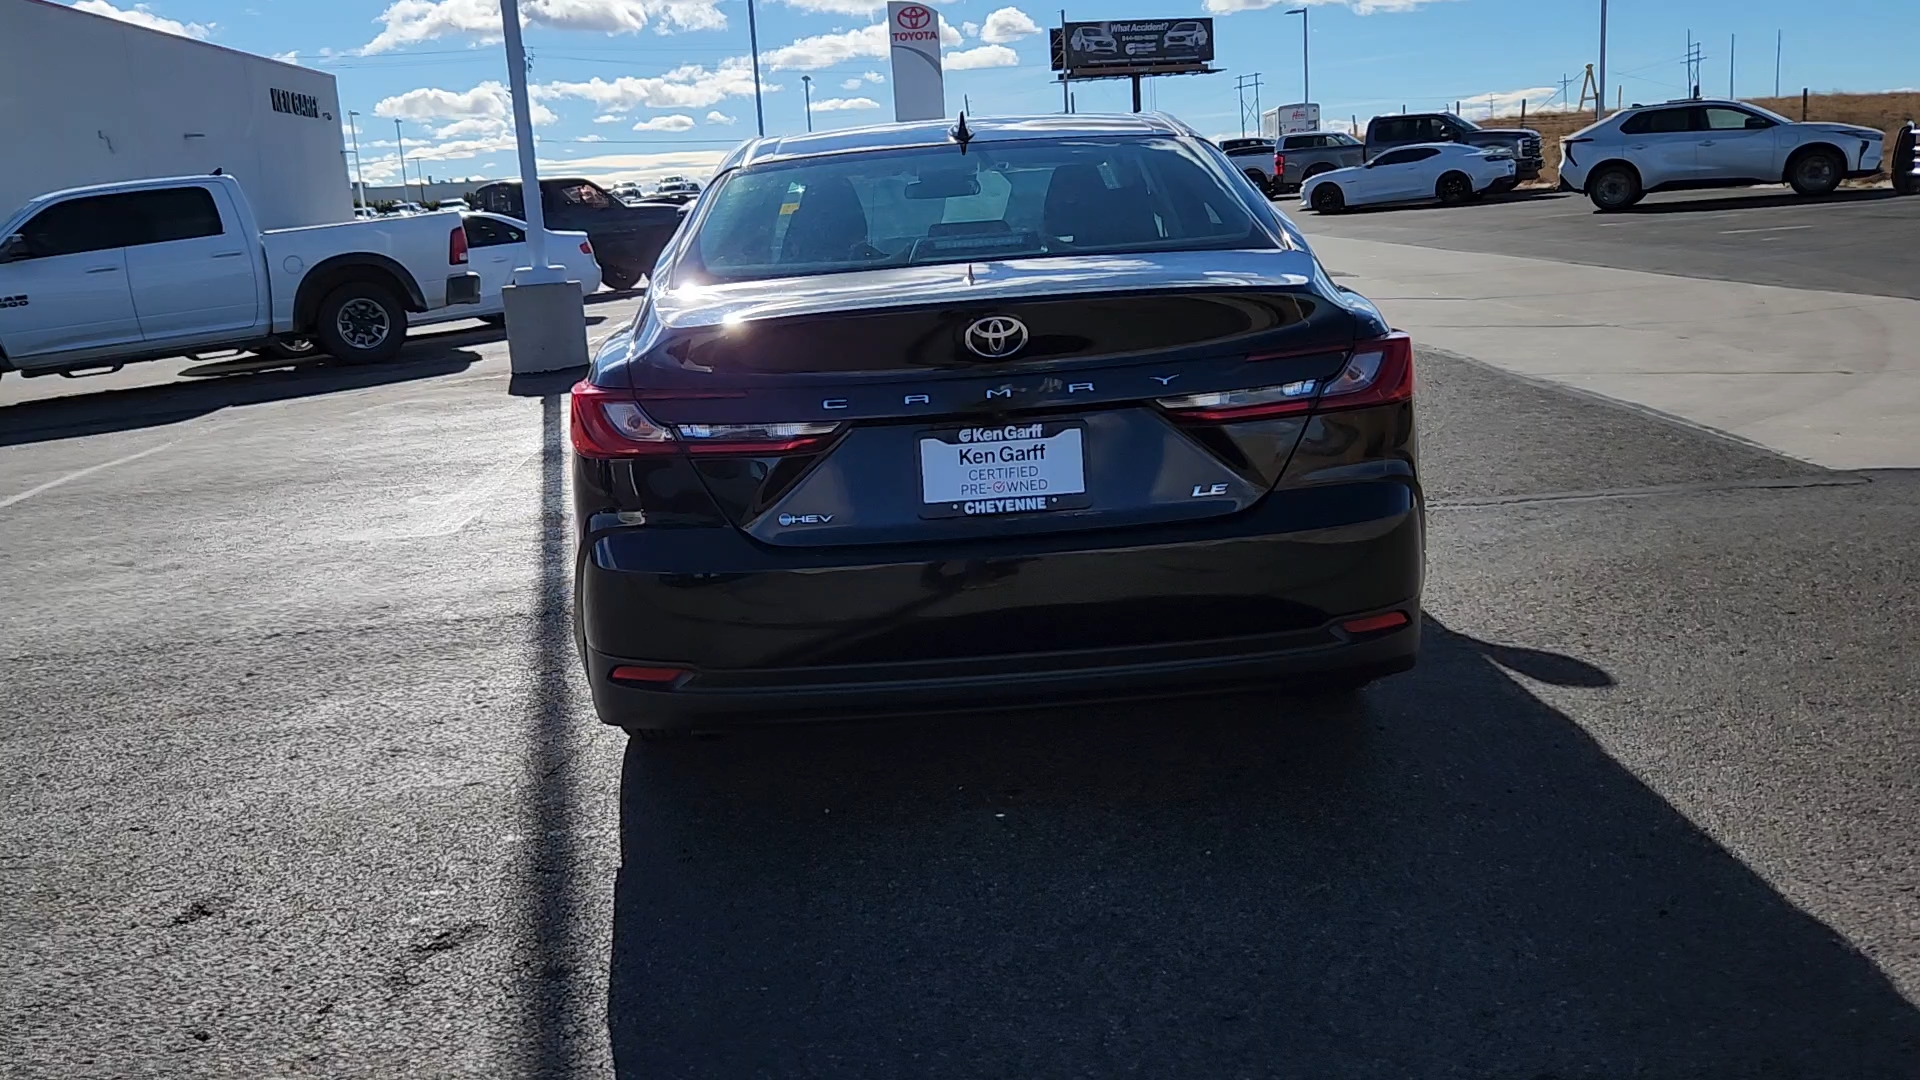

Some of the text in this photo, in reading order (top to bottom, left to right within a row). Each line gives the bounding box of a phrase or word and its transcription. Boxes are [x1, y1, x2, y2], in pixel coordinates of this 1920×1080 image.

[1110, 21, 1169, 33] What Accident?
[892, 31, 938, 42] TOYOTA
[270, 87, 292, 114] KEN
[823, 373, 1180, 410] CAMRY
[973, 424, 1043, 442] Ken Garff
[959, 443, 1046, 466] Ken Garff
[968, 465, 1039, 481] CERTIFIED
[1192, 483, 1228, 497] LE
[964, 497, 1047, 515] CHEYENNE
[792, 514, 835, 524] HEV
